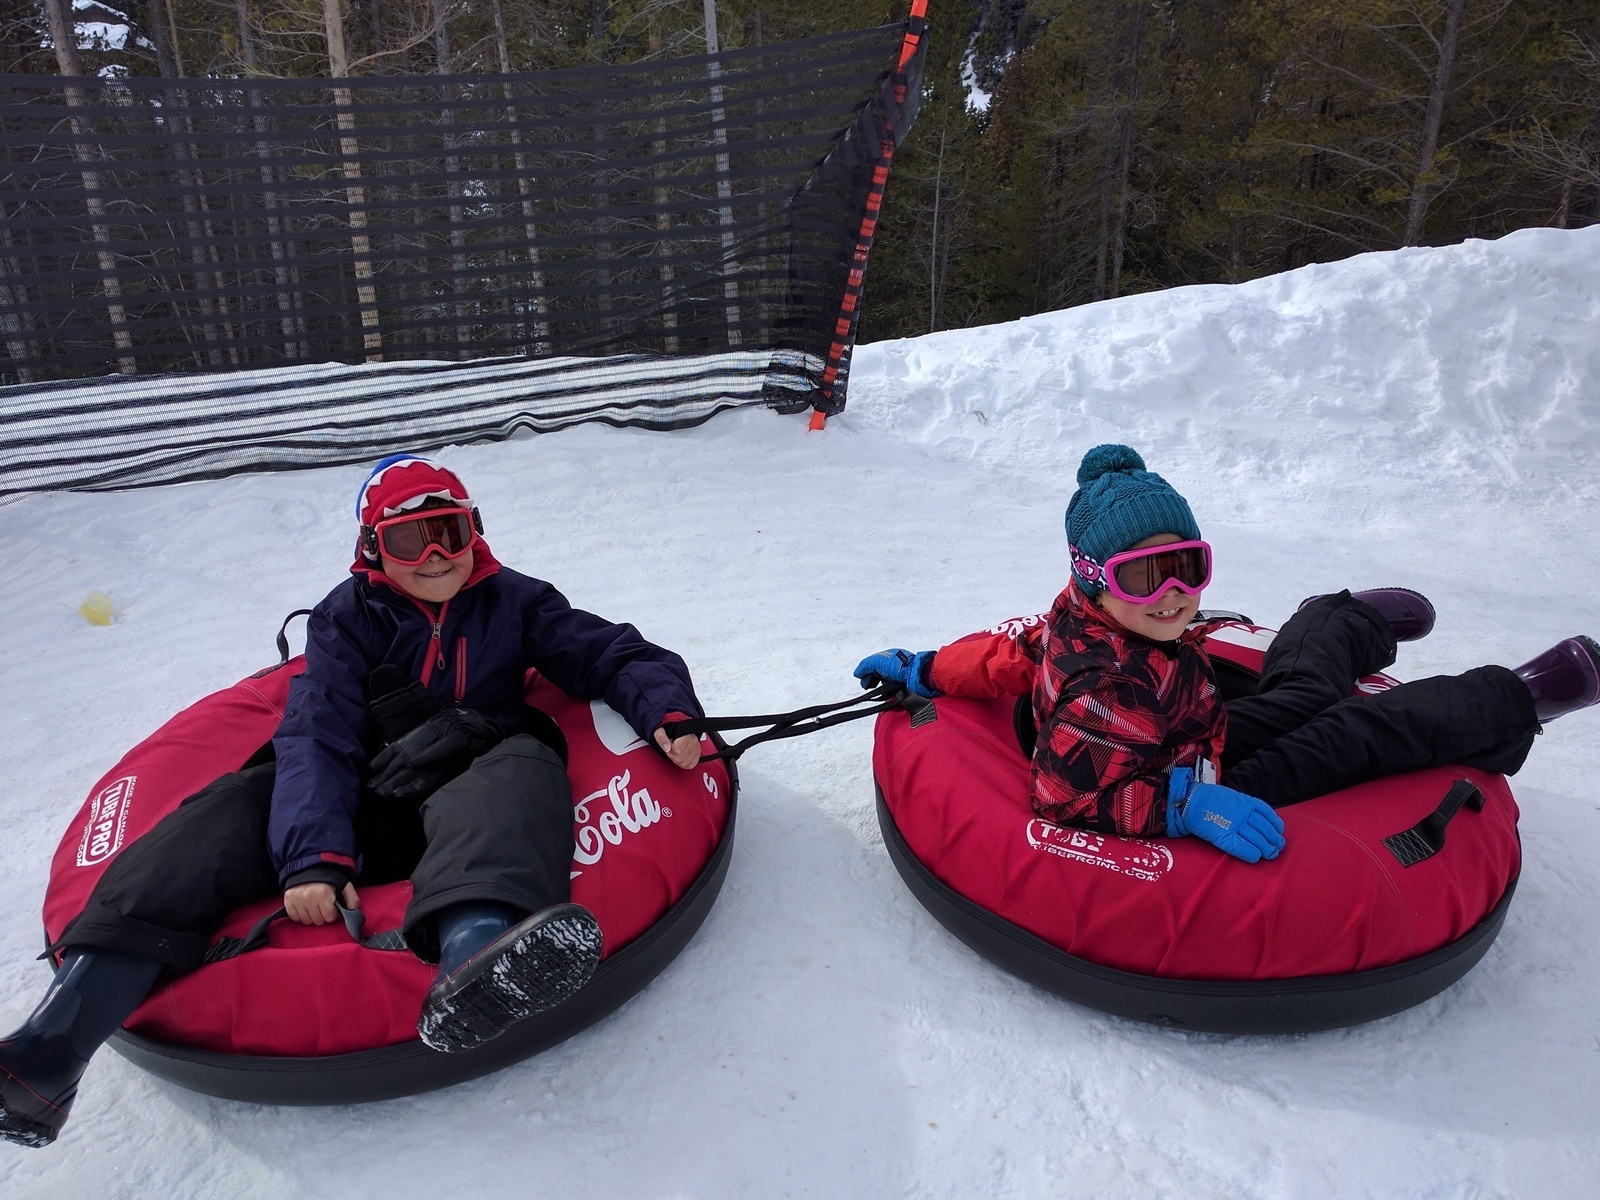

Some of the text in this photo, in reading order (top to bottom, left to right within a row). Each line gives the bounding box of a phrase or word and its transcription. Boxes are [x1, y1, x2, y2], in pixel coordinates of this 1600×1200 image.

[128, 776, 137, 798] MADE
[90, 782, 124, 856] TUBE PRO
[117, 809, 129, 848] CANADA
